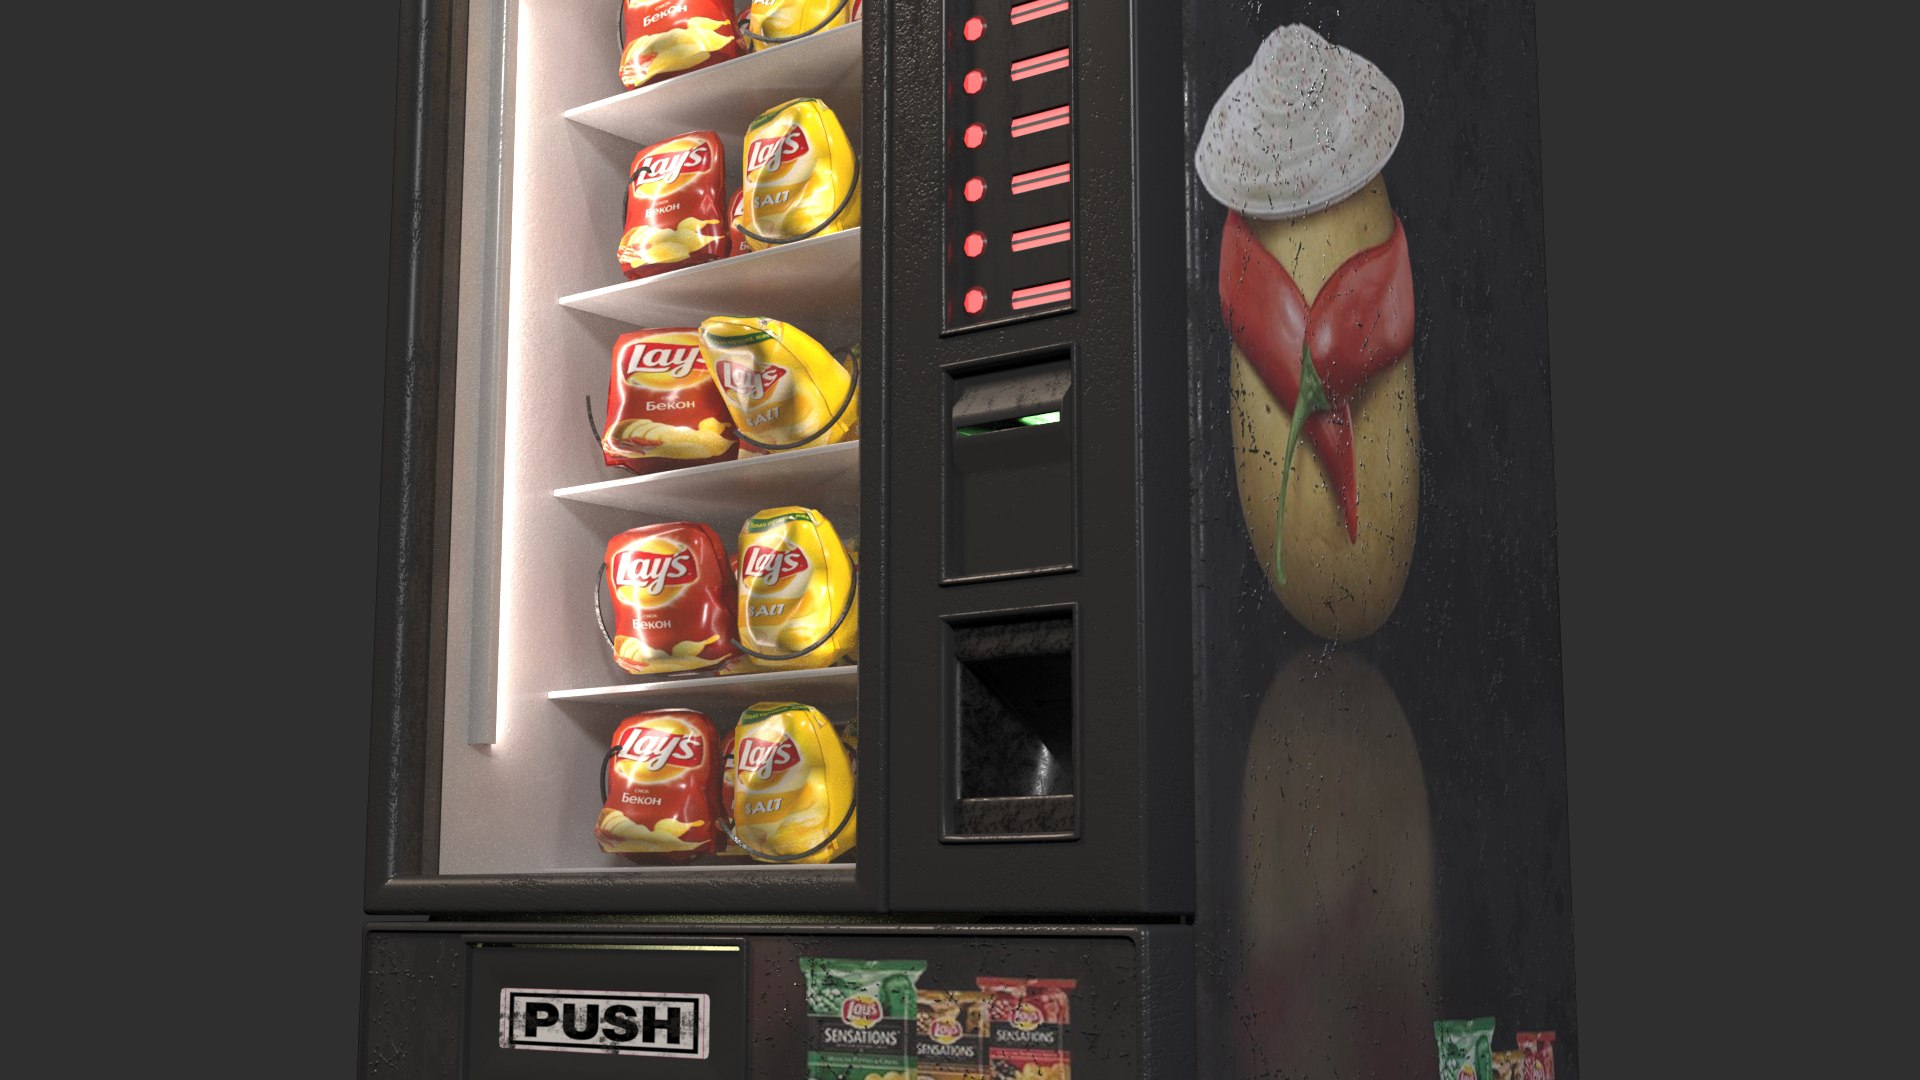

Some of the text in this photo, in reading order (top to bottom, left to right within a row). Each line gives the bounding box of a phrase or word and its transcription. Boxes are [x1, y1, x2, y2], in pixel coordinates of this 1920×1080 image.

[646, 400, 695, 411] Бекон
[616, 551, 690, 595] Lay's
[745, 547, 801, 586] Lay's
[632, 618, 672, 630] Бекон
[618, 728, 700, 771] Lay's
[739, 740, 792, 780] Lay's
[621, 792, 662, 806] Бекон
[745, 798, 783, 815] SALT
[525, 1002, 680, 1044] PUSH
[824, 1027, 898, 1046] SENSATIONS
